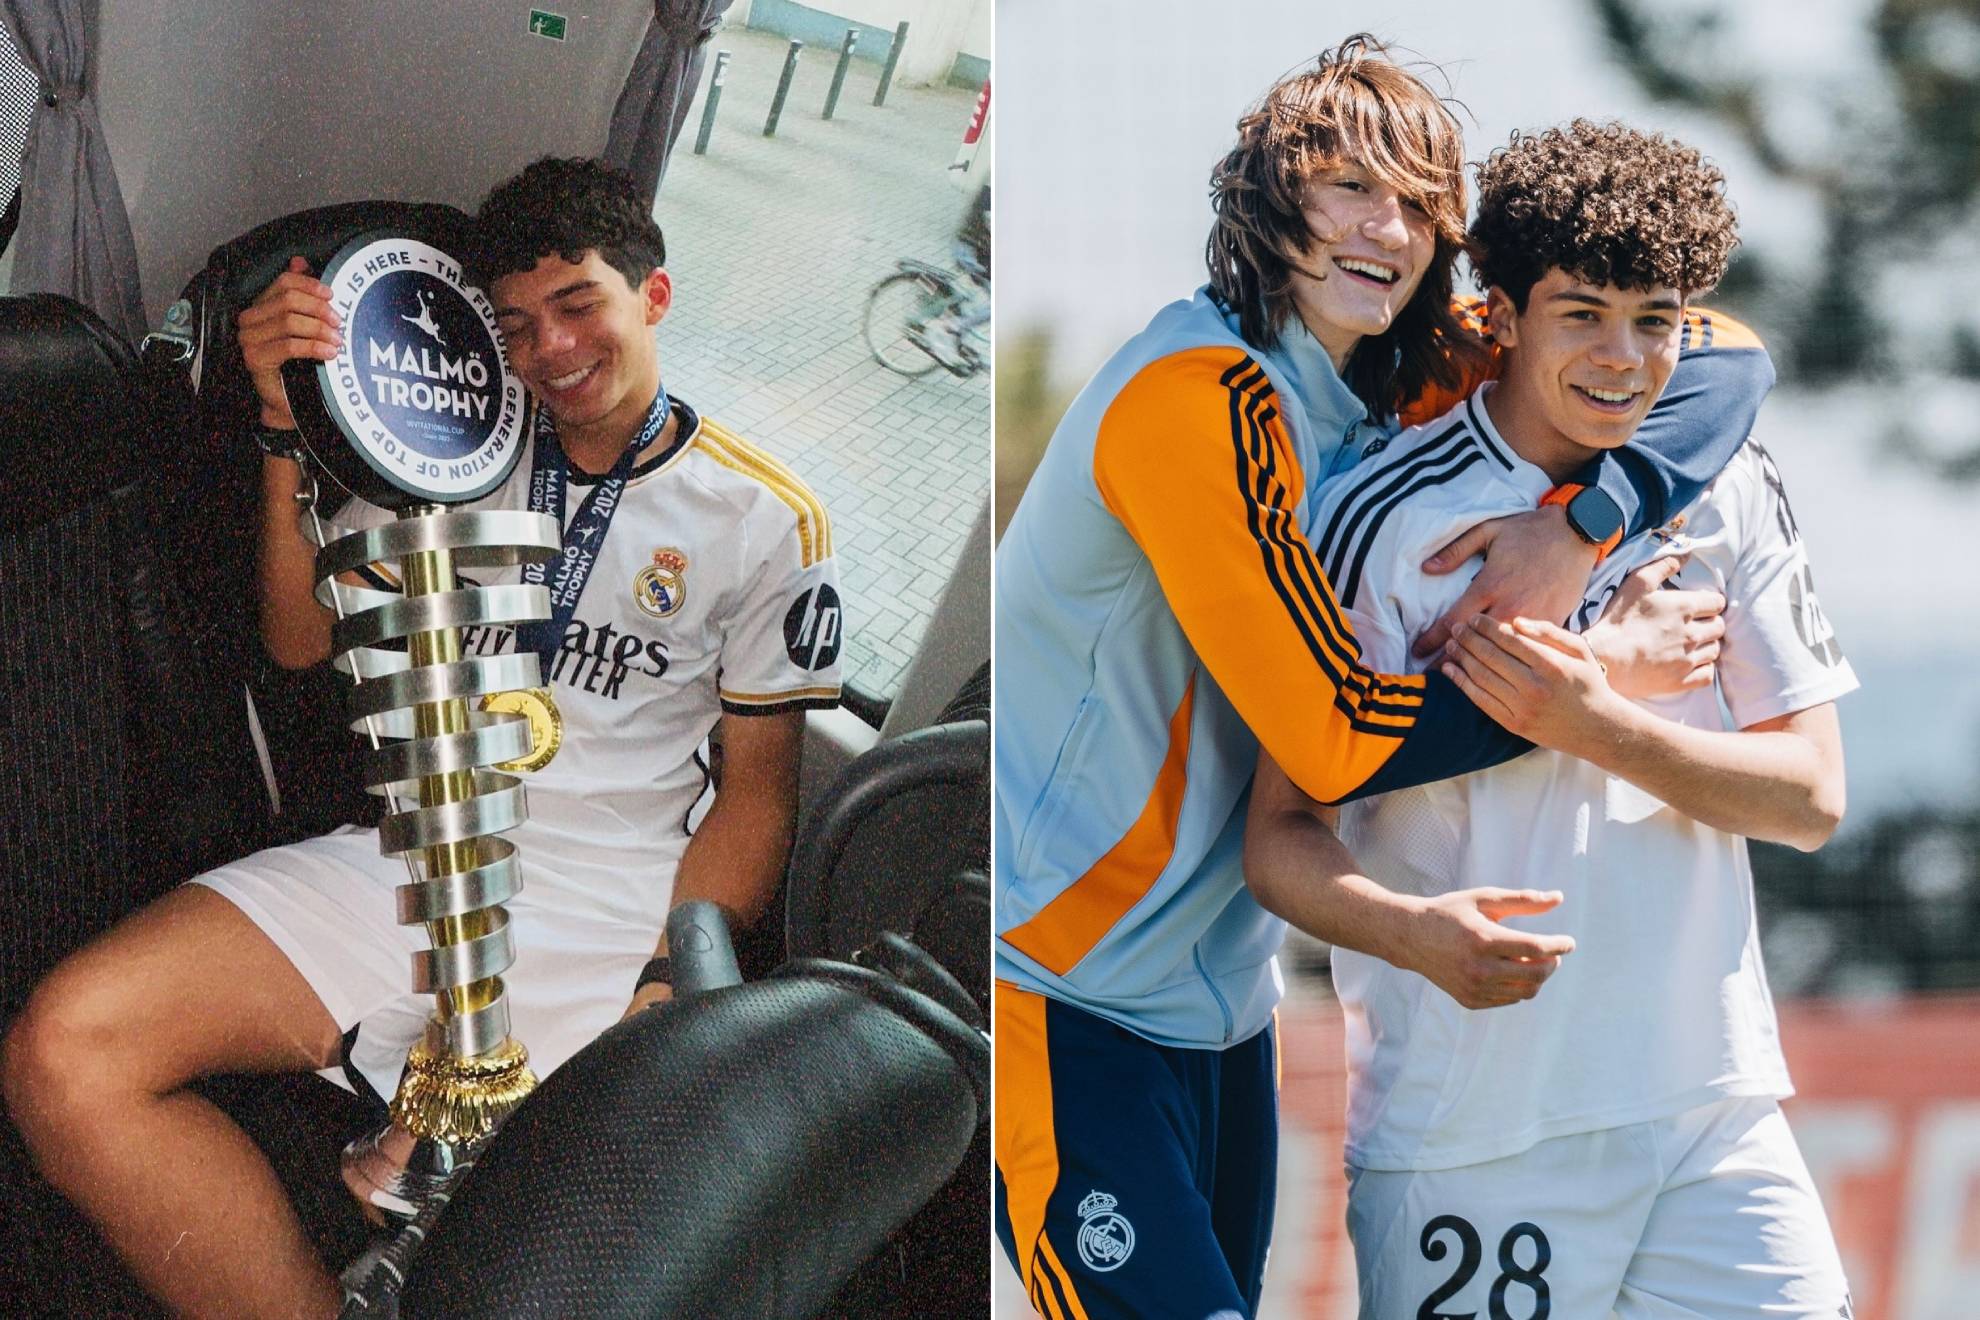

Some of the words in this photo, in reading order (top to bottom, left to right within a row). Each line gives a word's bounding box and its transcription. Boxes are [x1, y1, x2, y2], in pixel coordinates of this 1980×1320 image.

[347, 274, 365, 294] IS
[364, 251, 412, 276] HERE
[369, 336, 489, 388] MALMÖ
[371, 374, 490, 420] TROPHY
[371, 429, 407, 466] TOP
[449, 385, 517, 480] GENERATION
[416, 460, 441, 478] OF
[531, 468, 545, 512] TROPH
[544, 469, 559, 516] MALM
[591, 479, 623, 518] 2024
[551, 545, 580, 606] MALMÖ
[560, 549, 594, 609] TROPHY
[1416, 1214, 1552, 1320] 28
